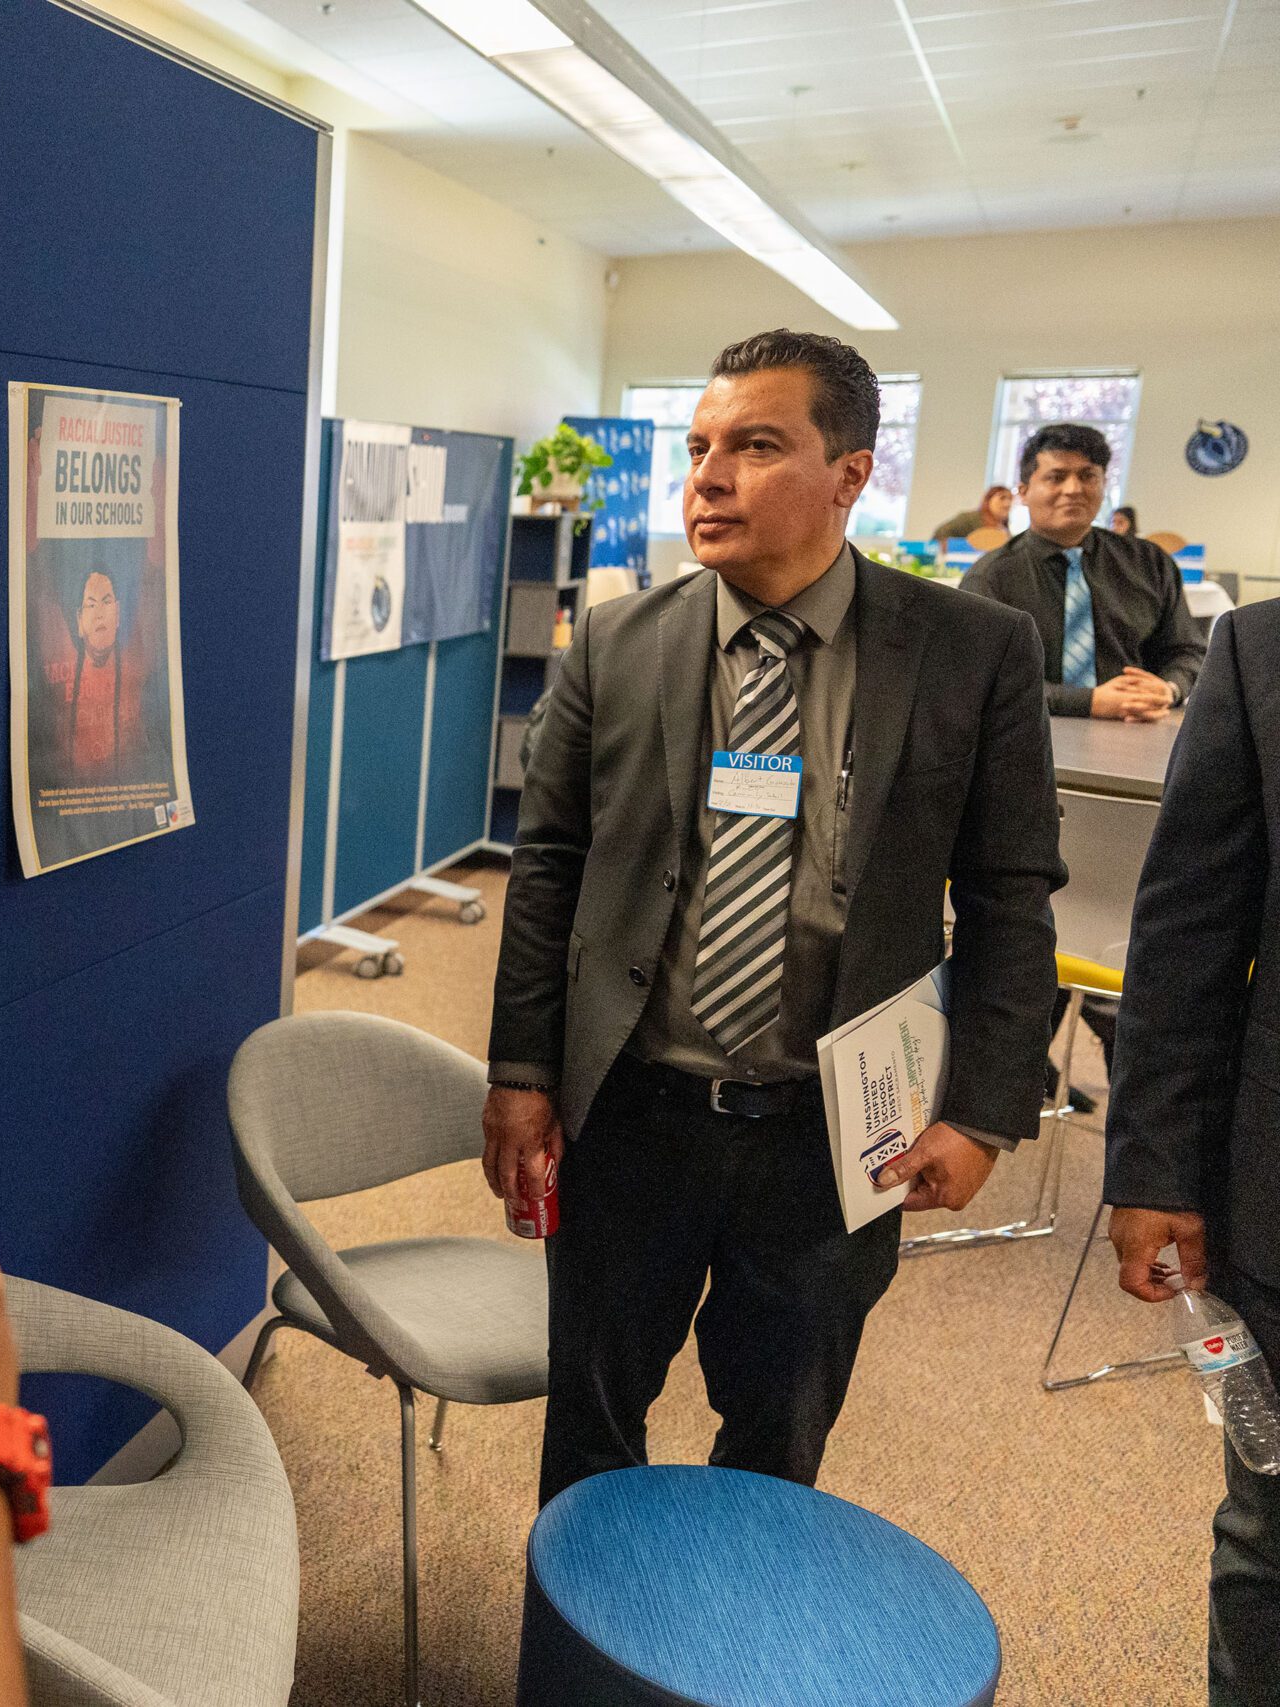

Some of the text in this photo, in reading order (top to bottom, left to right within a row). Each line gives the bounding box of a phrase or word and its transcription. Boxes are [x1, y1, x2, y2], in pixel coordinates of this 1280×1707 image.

[60, 416, 144, 447] RACIAL JUSTICE
[55, 449, 141, 495] BELONGS
[55, 501, 143, 525] IN OUR SCHOOLS
[728, 753, 793, 771] VISITOR
[859, 1051, 872, 1133] WASHINGTON
[871, 1080, 882, 1129] UNIFIED
[879, 1073, 889, 1124] SCHOOL
[884, 1065, 897, 1118] DISTRICT
